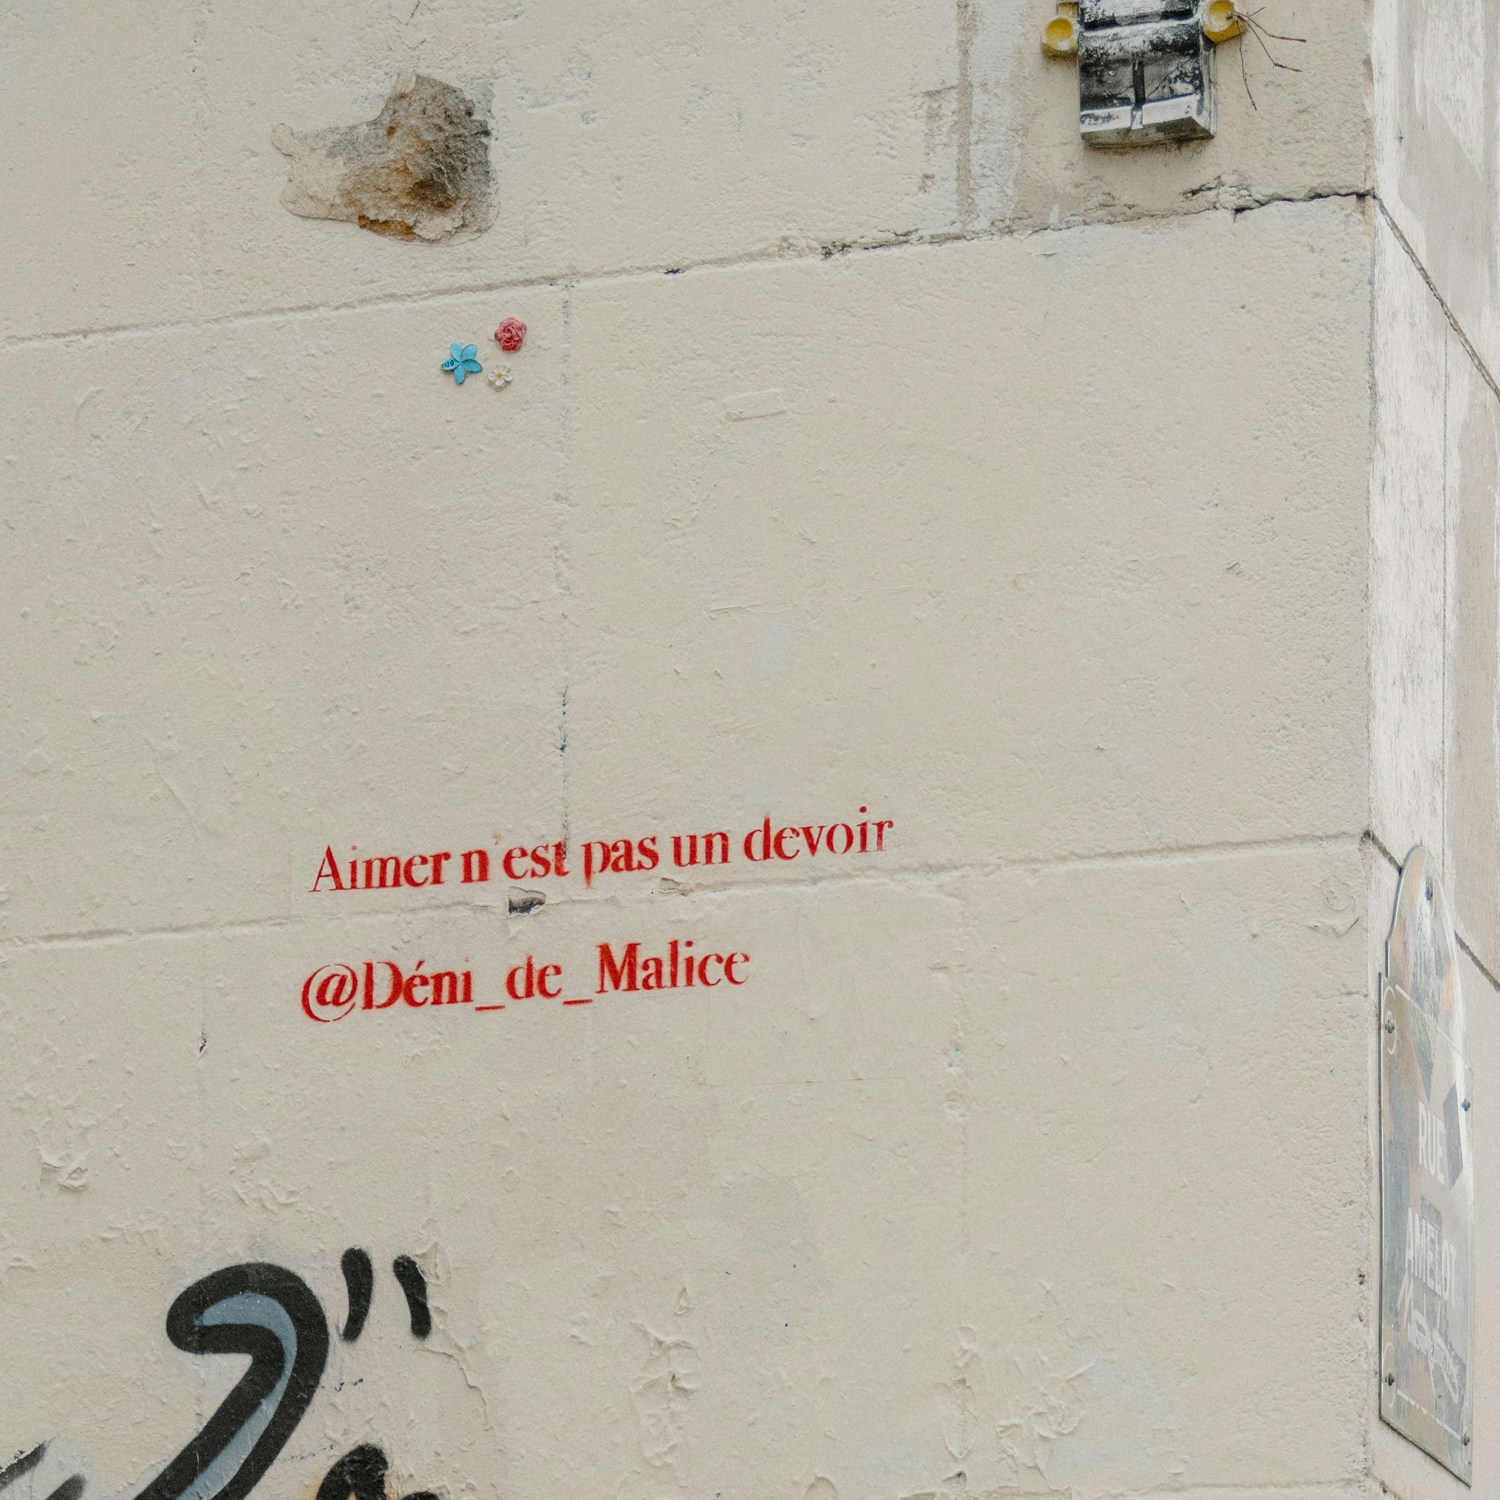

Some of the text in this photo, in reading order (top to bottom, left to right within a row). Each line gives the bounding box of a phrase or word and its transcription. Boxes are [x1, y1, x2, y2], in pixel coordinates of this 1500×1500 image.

[308, 844, 455, 893] Aimer
[582, 835, 662, 889] pas
[672, 831, 731, 869] un
[743, 805, 895, 864] devoir
[300, 939, 752, 1023] @Déni_de_Malice
[1418, 1102, 1446, 1185] RUE
[1405, 1206, 1457, 1308] AMELOT
